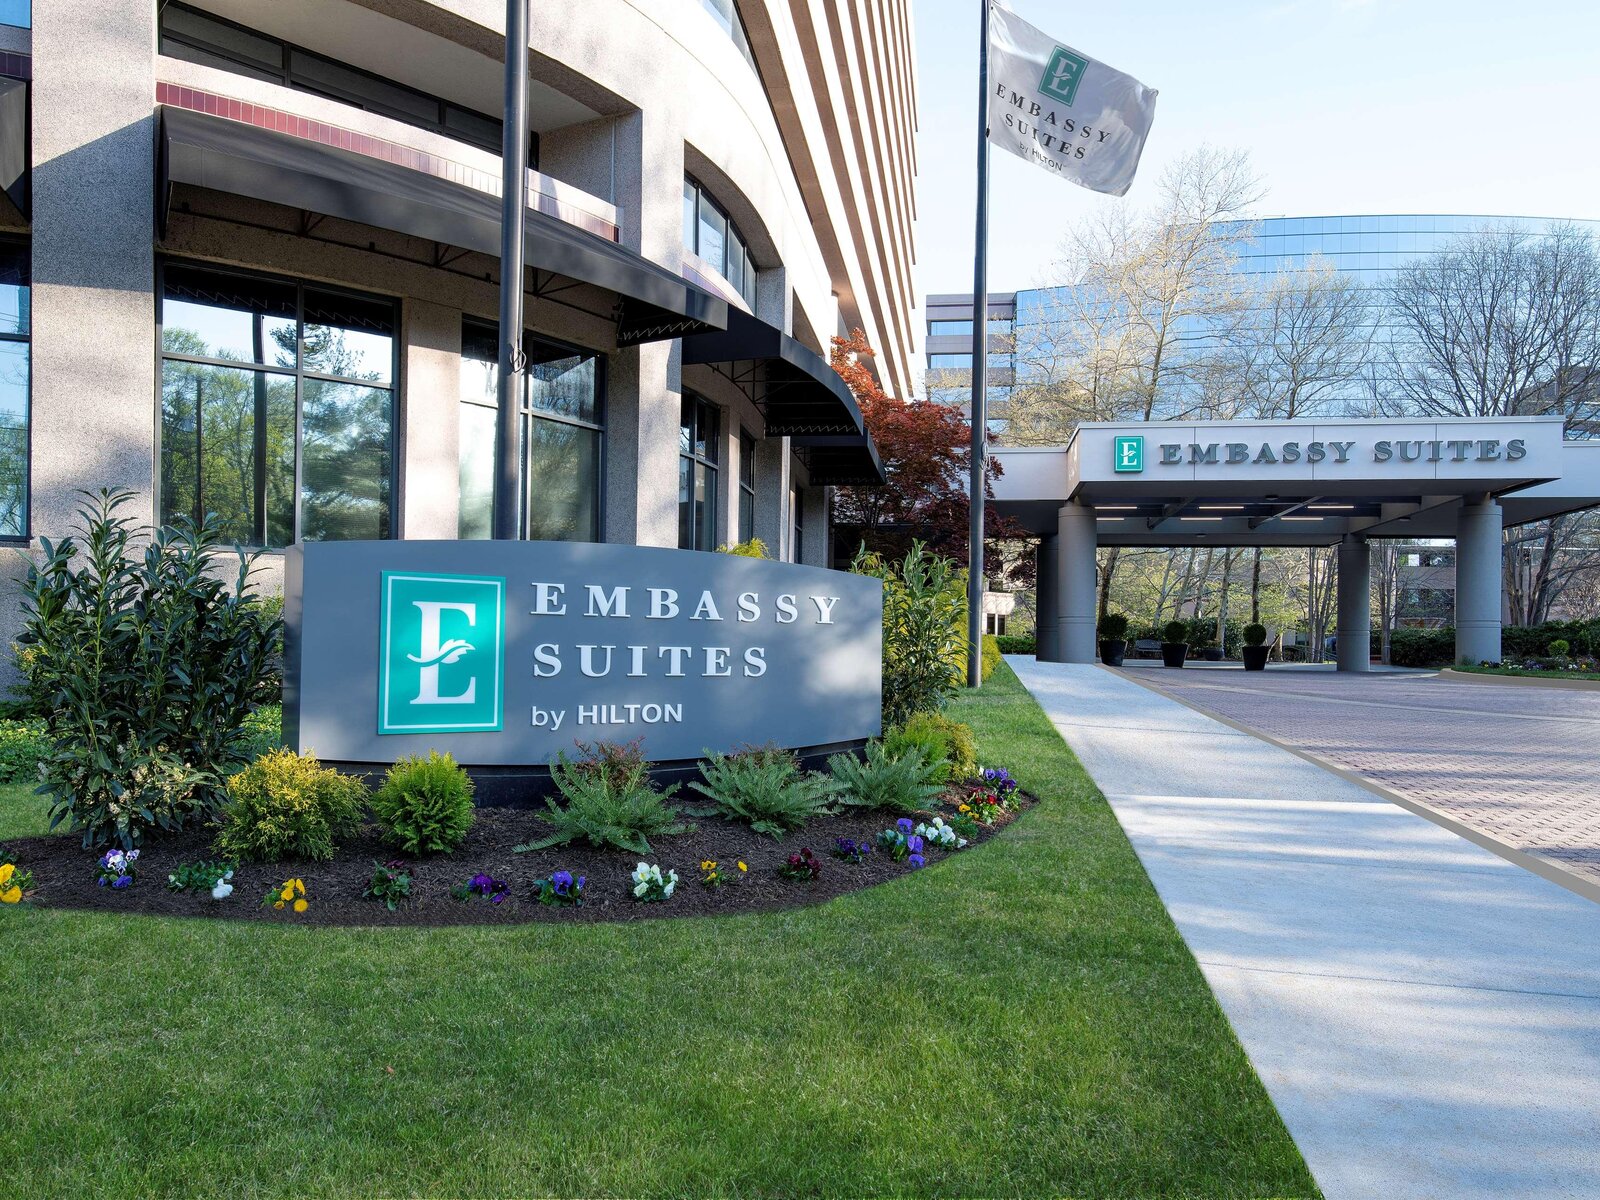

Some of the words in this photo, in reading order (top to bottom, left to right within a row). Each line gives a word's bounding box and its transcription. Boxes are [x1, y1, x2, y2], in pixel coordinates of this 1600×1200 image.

[996, 83, 1111, 144] EMBASSY
[1005, 113, 1086, 160] SUITES
[1019, 143, 1029, 155] by
[1031, 147, 1063, 171] HILTON
[1159, 441, 1356, 465] EMBASSY
[1373, 438, 1528, 463] SUITES
[530, 582, 841, 625] EMBASSY
[532, 643, 768, 679] SUITES
[531, 706, 566, 732] by
[577, 703, 683, 726] HILTON
